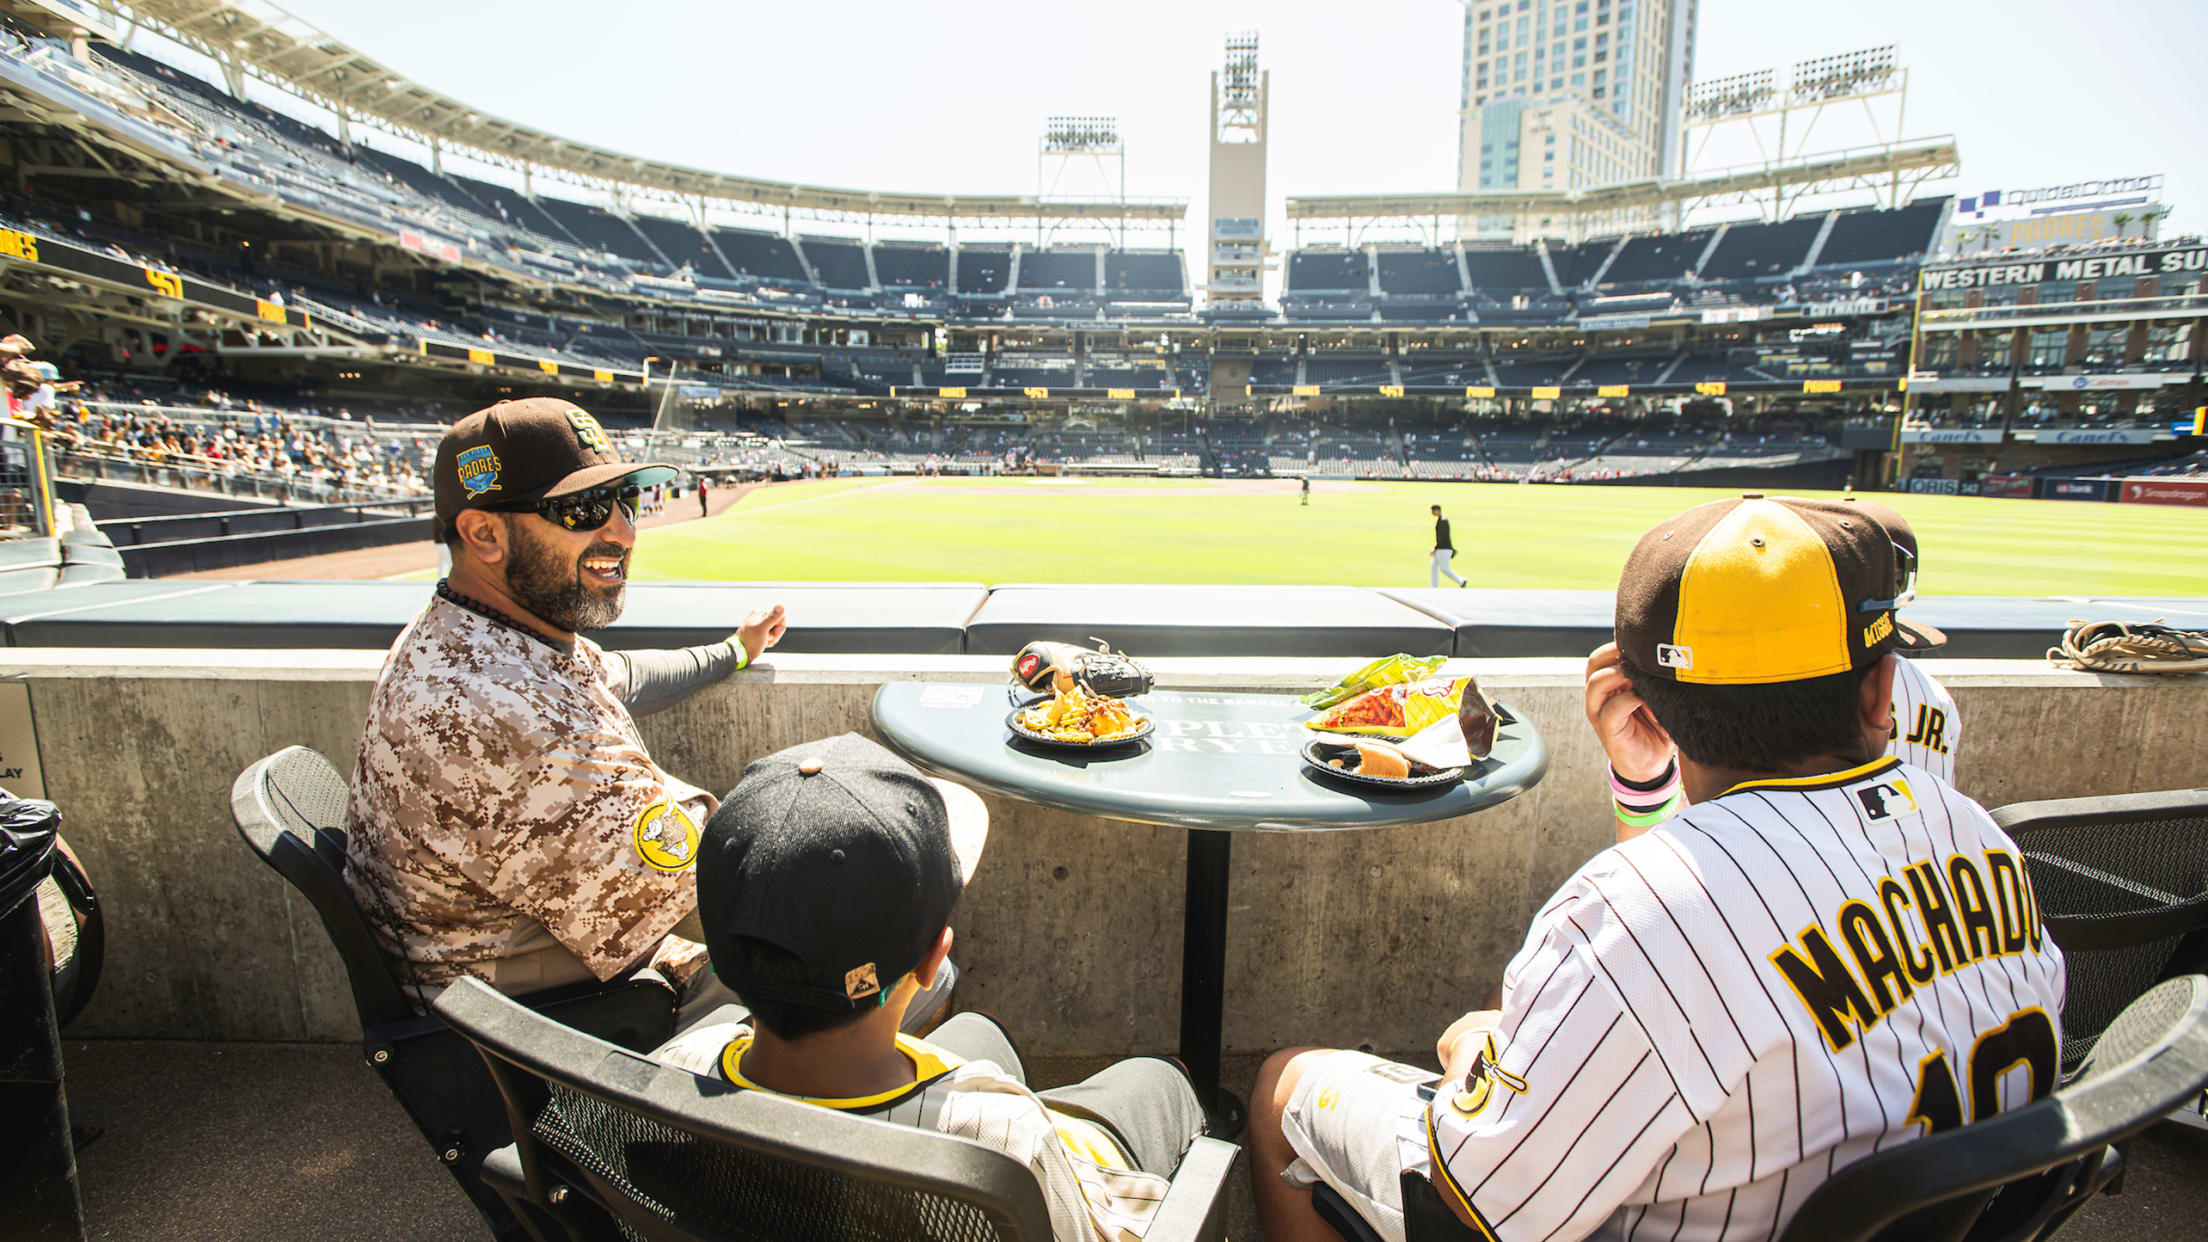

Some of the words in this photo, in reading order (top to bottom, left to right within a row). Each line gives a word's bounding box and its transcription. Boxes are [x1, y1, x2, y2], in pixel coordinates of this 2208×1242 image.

[2010, 215, 2105, 247] PADRES
[1923, 263, 2044, 290] WESTERN
[2056, 254, 2152, 280] METAL
[2160, 249, 2208, 272] SU
[457, 456, 502, 484] PADRES
[1906, 702, 1950, 755] JR.
[0, 767, 23, 778] AY
